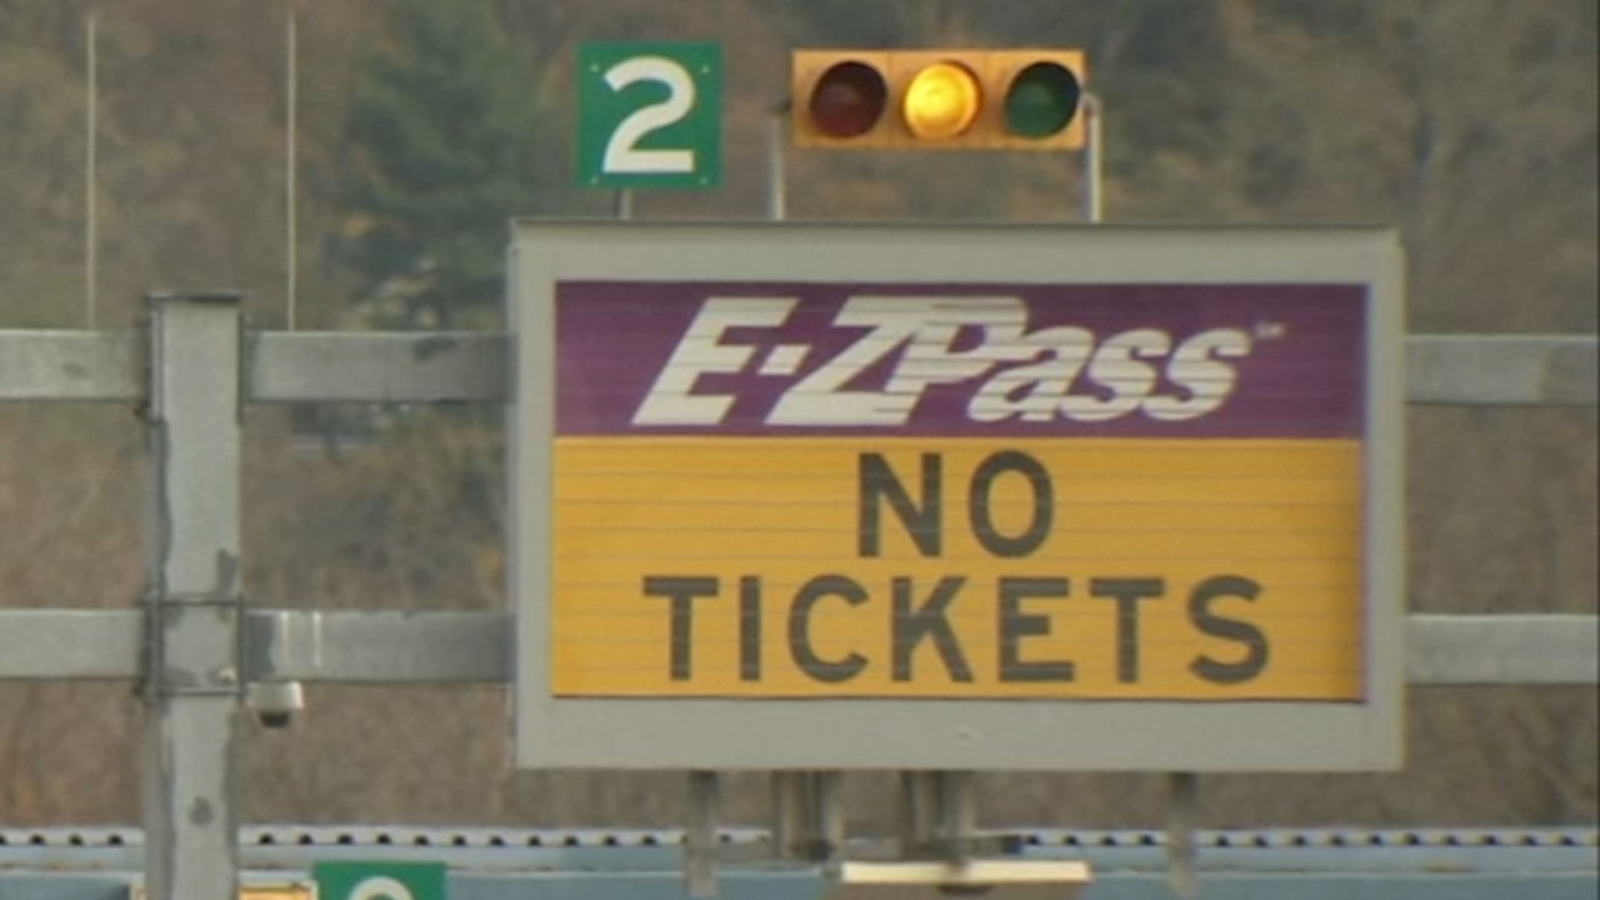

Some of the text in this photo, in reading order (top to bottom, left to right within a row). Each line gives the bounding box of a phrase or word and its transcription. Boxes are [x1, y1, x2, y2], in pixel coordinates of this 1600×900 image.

[603, 56, 696, 173] 2
[857, 450, 1056, 559] NO
[643, 574, 1270, 684] TICKETS
